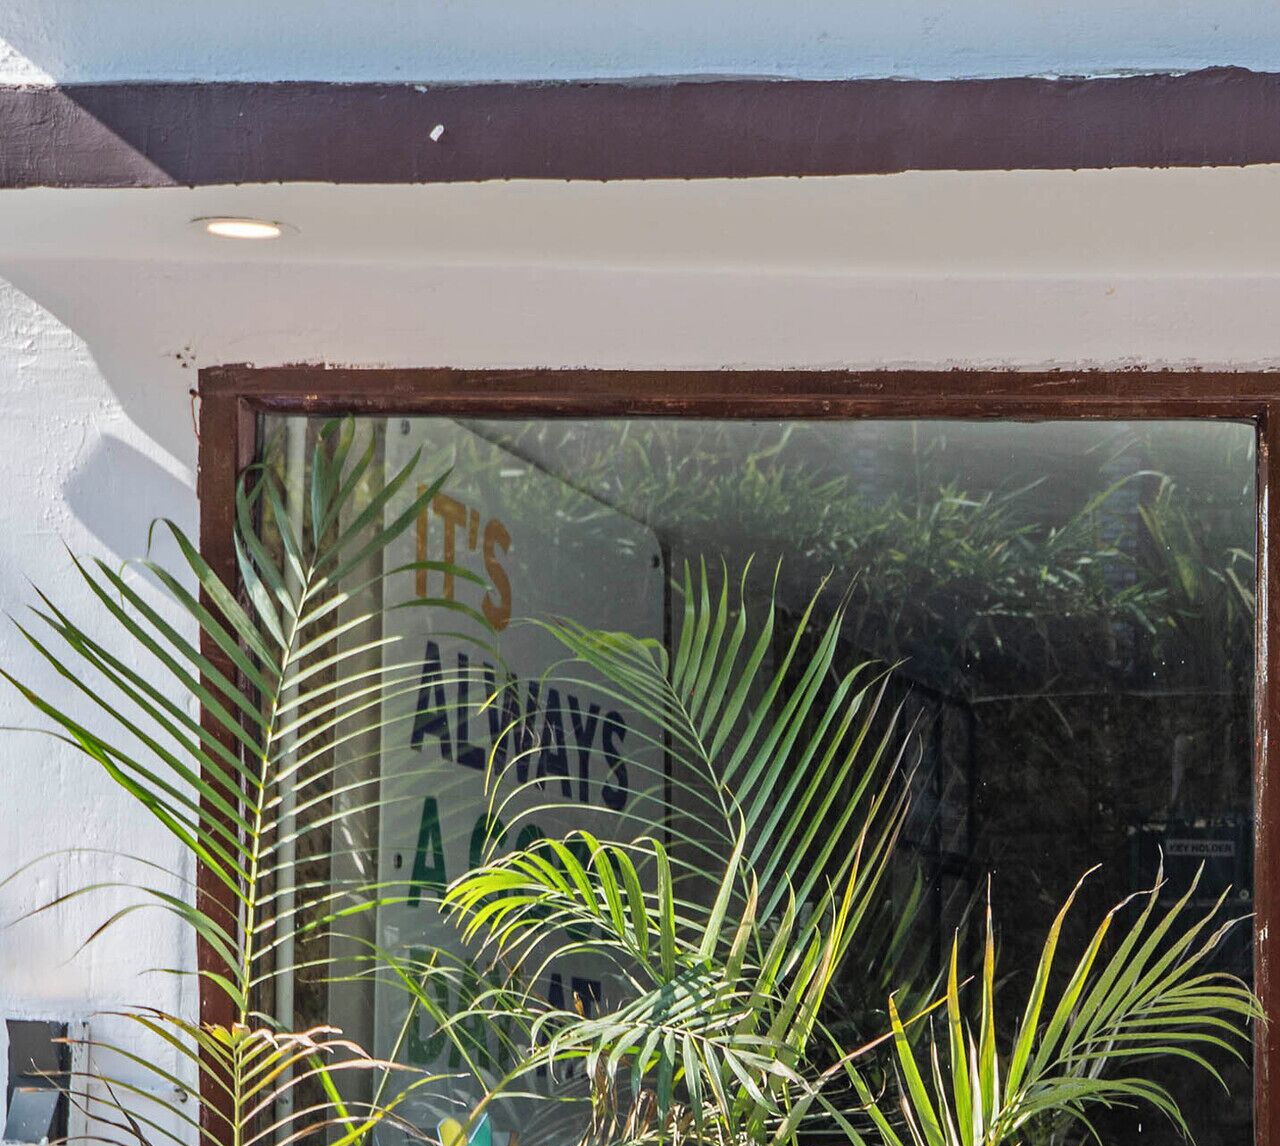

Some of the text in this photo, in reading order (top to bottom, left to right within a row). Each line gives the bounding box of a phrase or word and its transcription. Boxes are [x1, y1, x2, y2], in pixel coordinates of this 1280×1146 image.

[415, 484, 512, 632] IT'S
[410, 640, 629, 811] ALWAYS
[406, 795, 450, 912] A
